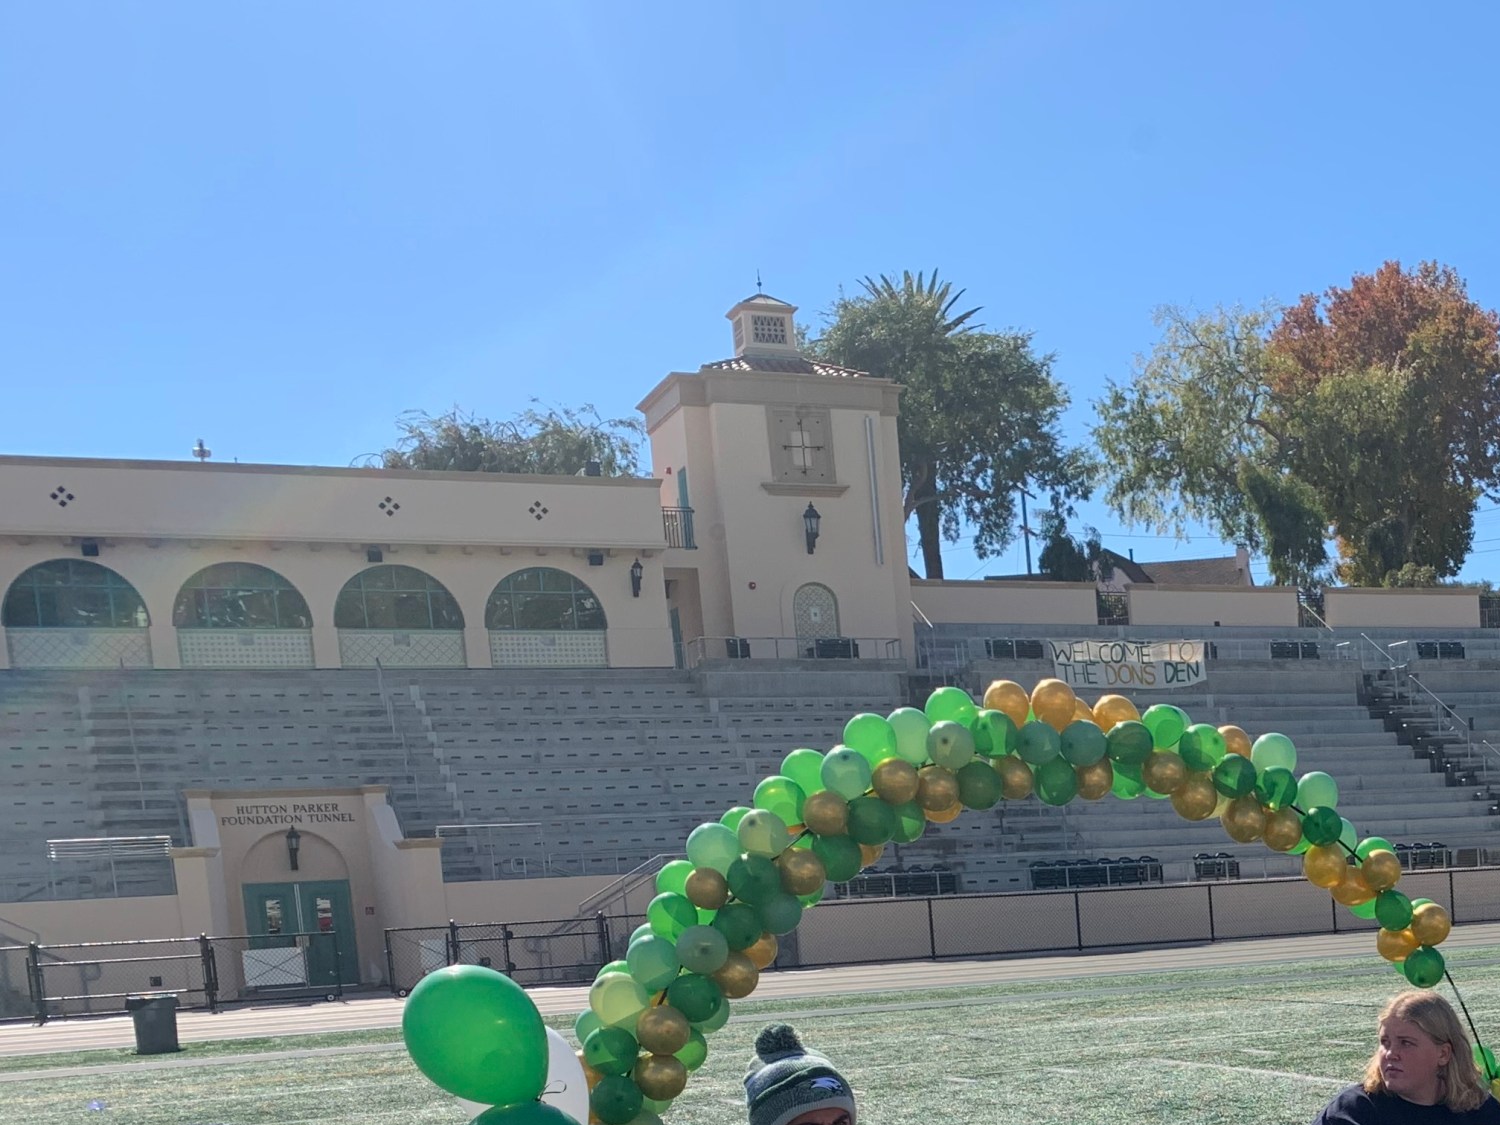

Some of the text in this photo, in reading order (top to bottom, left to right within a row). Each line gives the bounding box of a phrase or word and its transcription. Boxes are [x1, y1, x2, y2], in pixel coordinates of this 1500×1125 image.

[1048, 641, 1194, 664] WELCOME TO
[1057, 660, 1200, 685] THE DONS DEN
[236, 803, 339, 815] HUTTON PARKER
[221, 813, 355, 826] FOUNDATION TUNNEL
